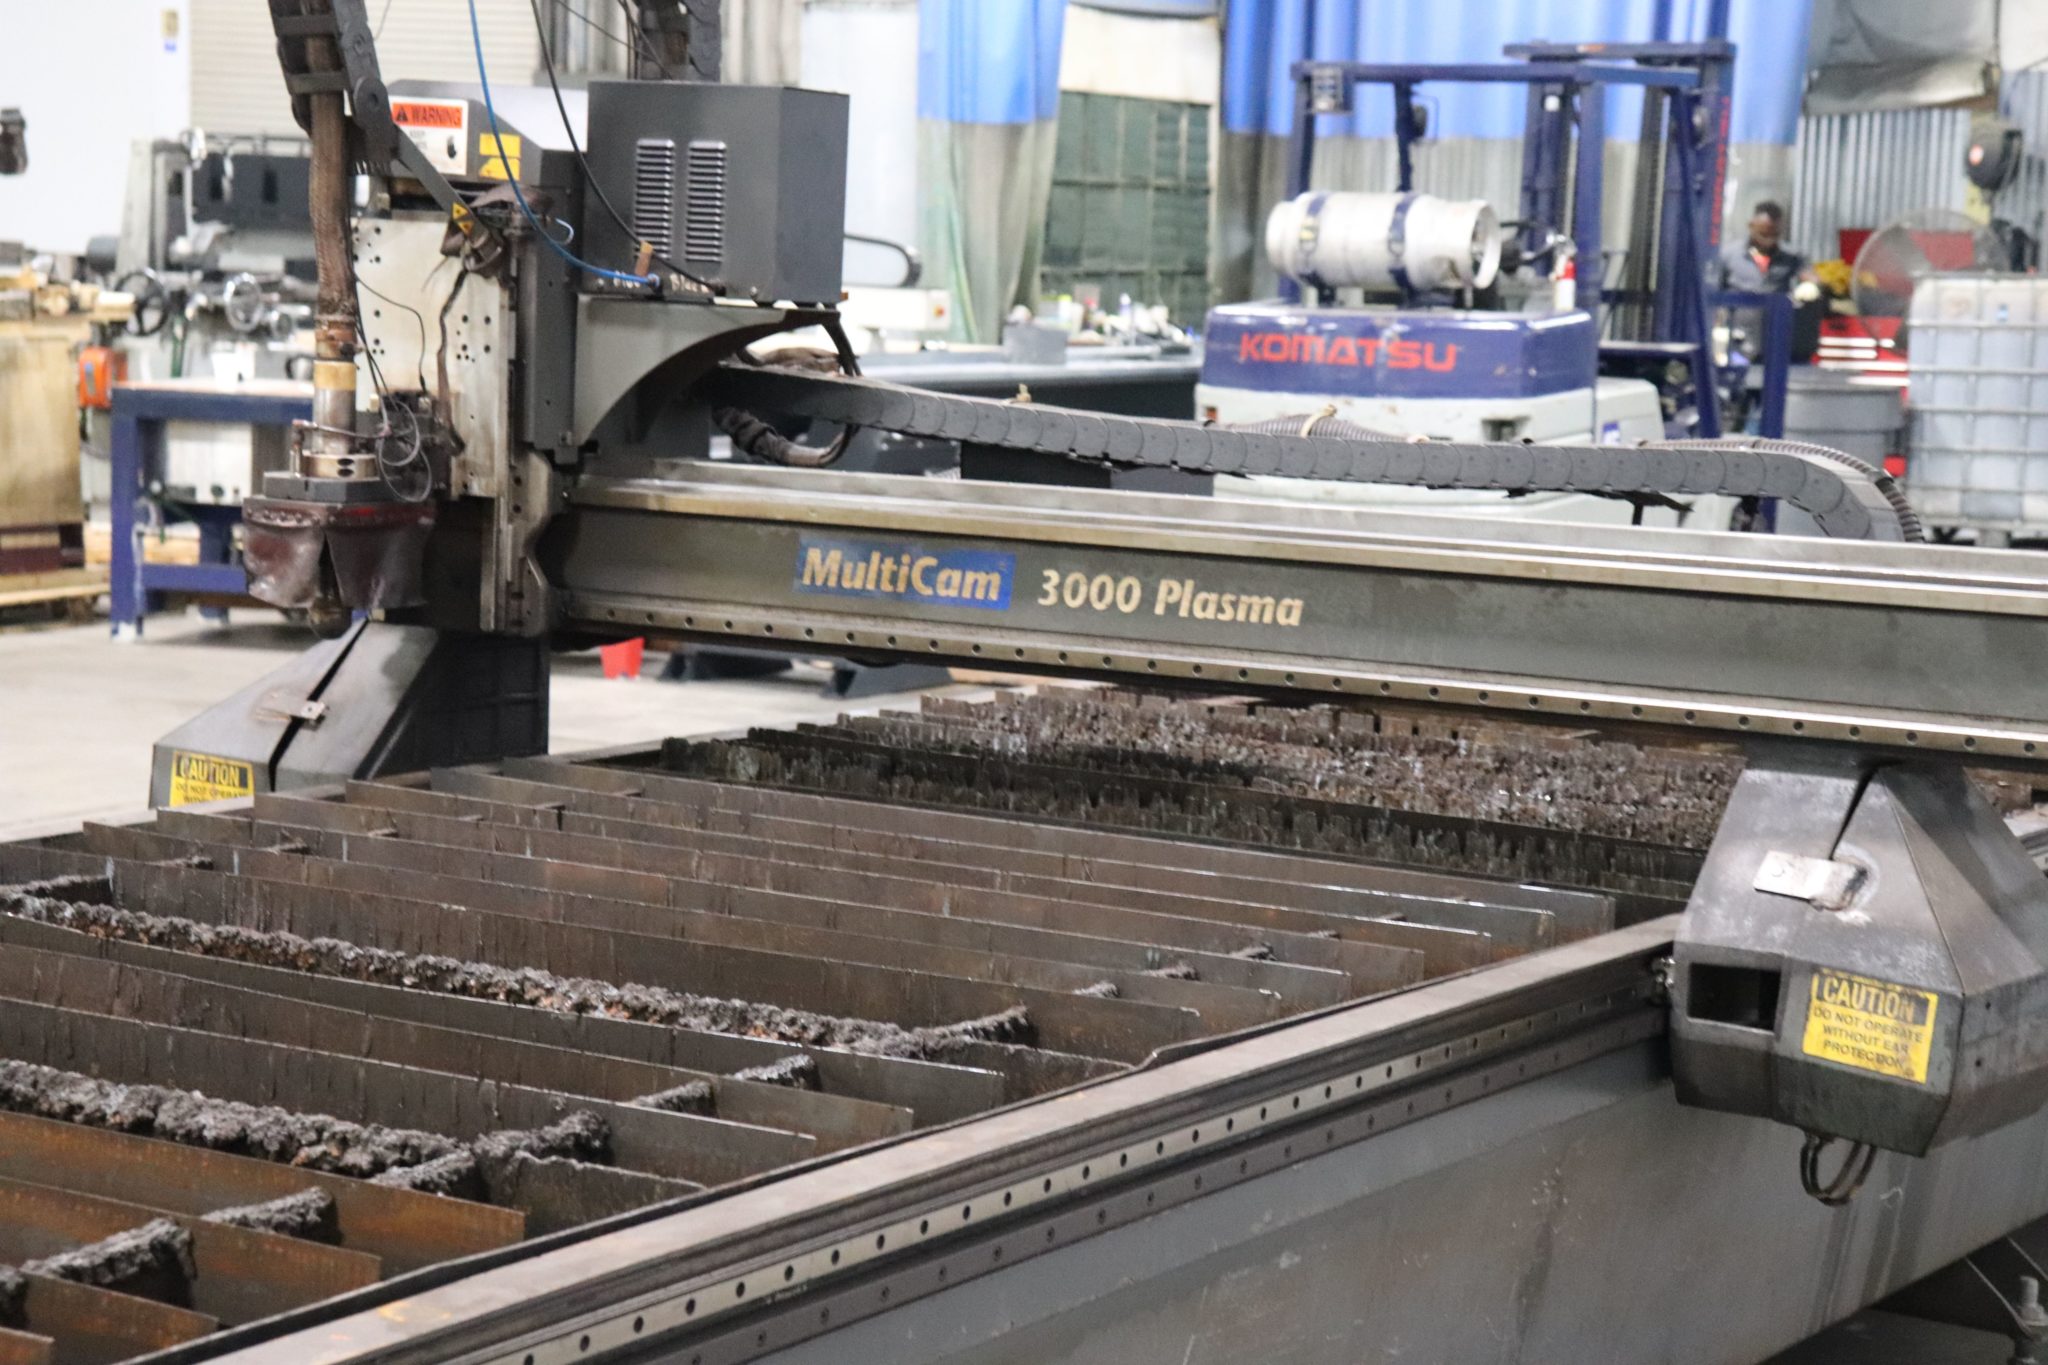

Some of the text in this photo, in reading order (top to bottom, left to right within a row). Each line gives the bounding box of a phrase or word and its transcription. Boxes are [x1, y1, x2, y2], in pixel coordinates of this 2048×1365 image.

[411, 106, 461, 124] WARNING
[1239, 332, 1457, 373] KOMATSU
[802, 547, 1304, 626] MultiCam 3000 Plasma
[180, 755, 240, 787] CAUTION
[1823, 976, 1916, 1025] CAUTION
[1813, 1006, 1923, 1043] DO NOT OPERATE
[1823, 1024, 1880, 1046] WITHOUT
